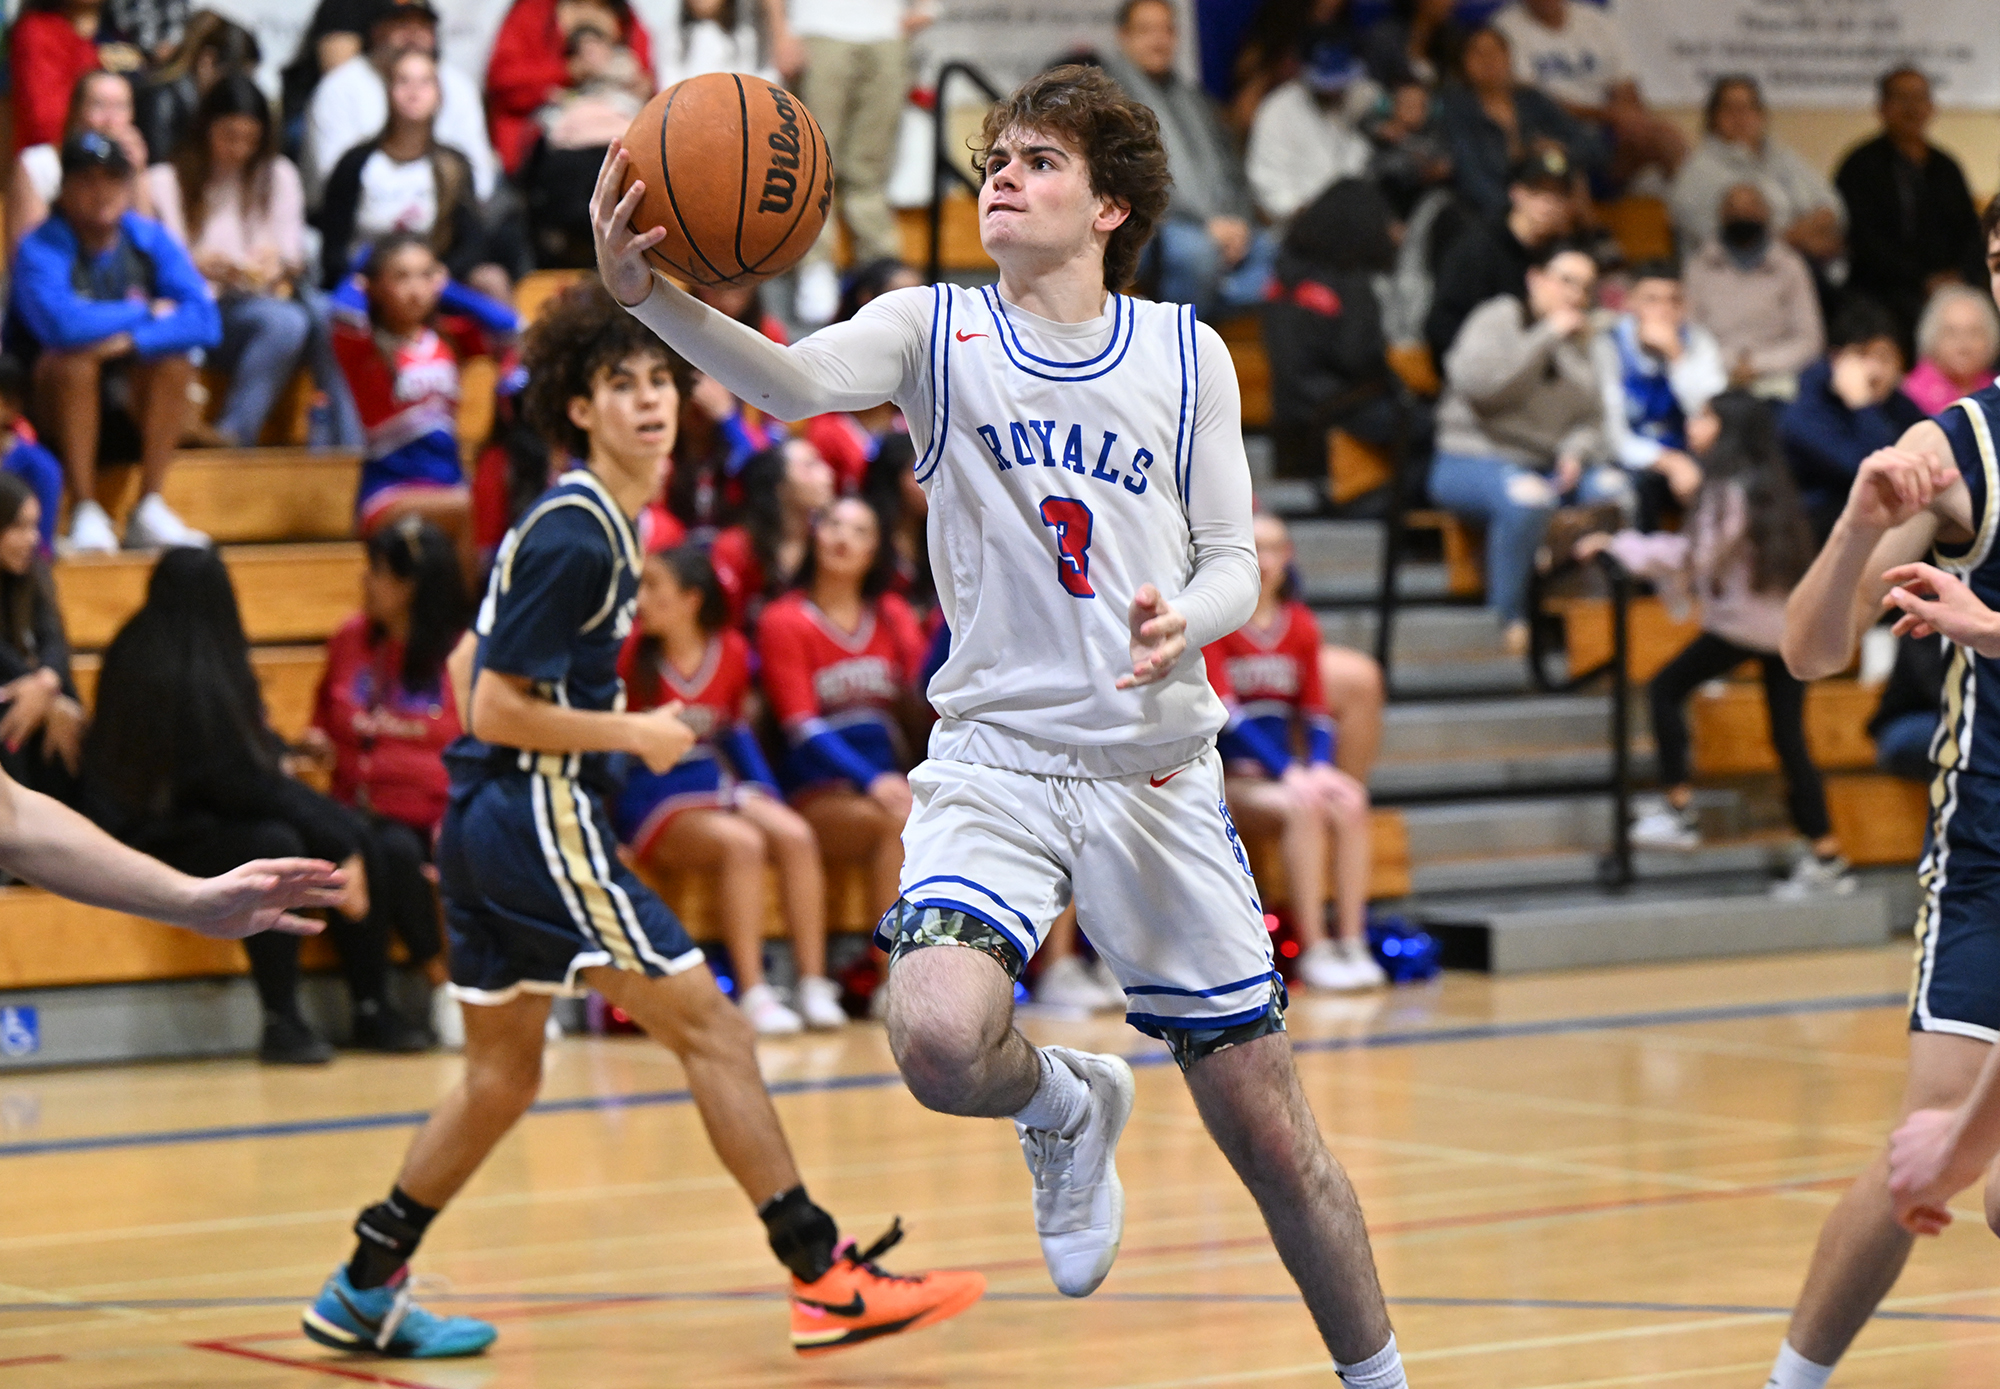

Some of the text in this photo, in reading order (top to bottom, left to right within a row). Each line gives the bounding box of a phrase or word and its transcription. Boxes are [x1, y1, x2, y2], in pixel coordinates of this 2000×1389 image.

[758, 86, 800, 213] Wilson
[976, 420, 1154, 495] ROYALS
[1039, 495, 1096, 599] 3
